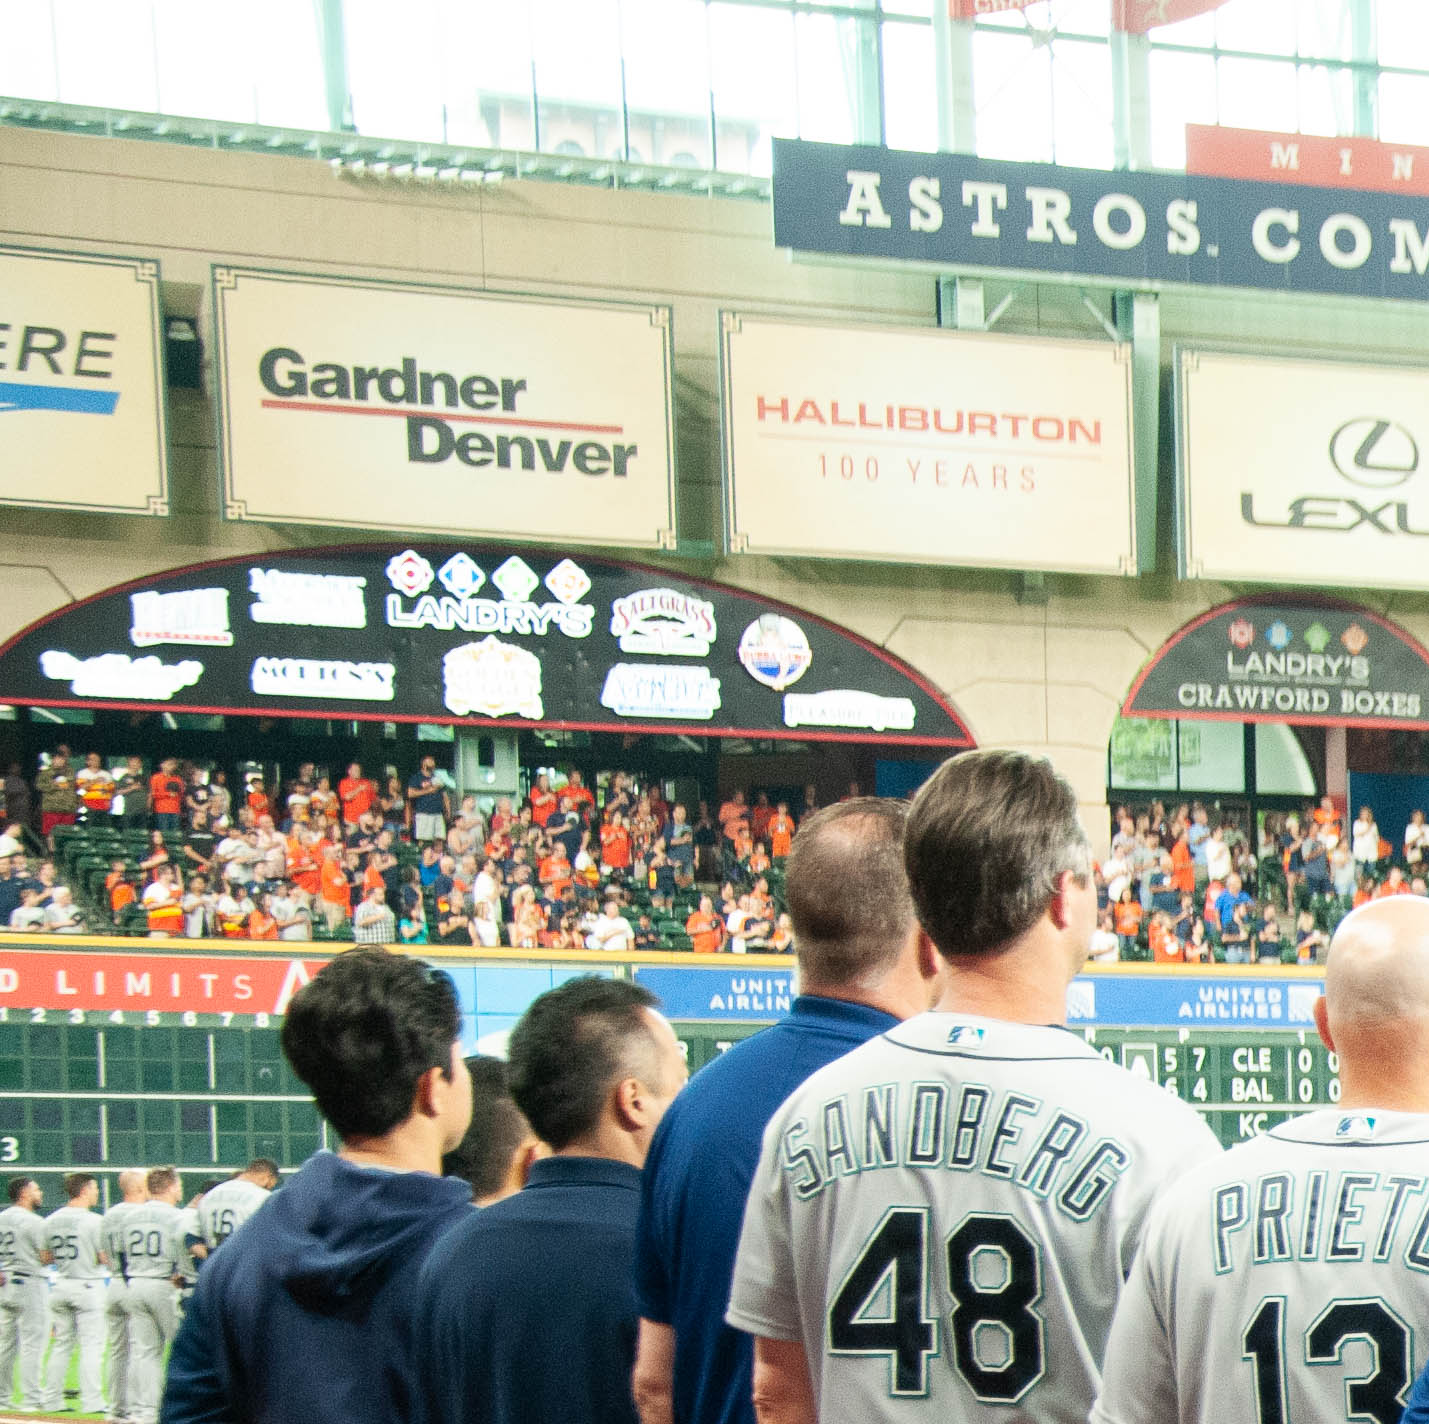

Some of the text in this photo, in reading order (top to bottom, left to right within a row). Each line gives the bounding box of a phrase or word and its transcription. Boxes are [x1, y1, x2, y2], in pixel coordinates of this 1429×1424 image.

[258, 346, 527, 413] Gardner
[756, 395, 1102, 446] HALLIBURTON
[406, 415, 638, 478] Denver
[819, 453, 1038, 492] 100 YEARS
[390, 597, 592, 634] LANDRY'S
[1227, 651, 1370, 679] LANDRY'S
[1178, 683, 1421, 717] CRAWFORD BOXES
[57, 970, 254, 1000] LIMITS
[1199, 987, 1282, 1003] UNITED
[1179, 1002, 1283, 1019] AIRLINES
[1232, 1048, 1272, 1073] CLE
[1298, 1049, 1313, 1073] 0
[1231, 1078, 1274, 1102] BAL
[1299, 1079, 1313, 1103] 0
[1239, 1113, 1268, 1138] KC
[1, 1136, 20, 1162] 3
[782, 1081, 1132, 1224] SANDBERG
[211, 1209, 235, 1235] 16
[51, 1235, 79, 1260] 25
[129, 1230, 162, 1257] 20
[828, 1204, 1047, 1404] 48
